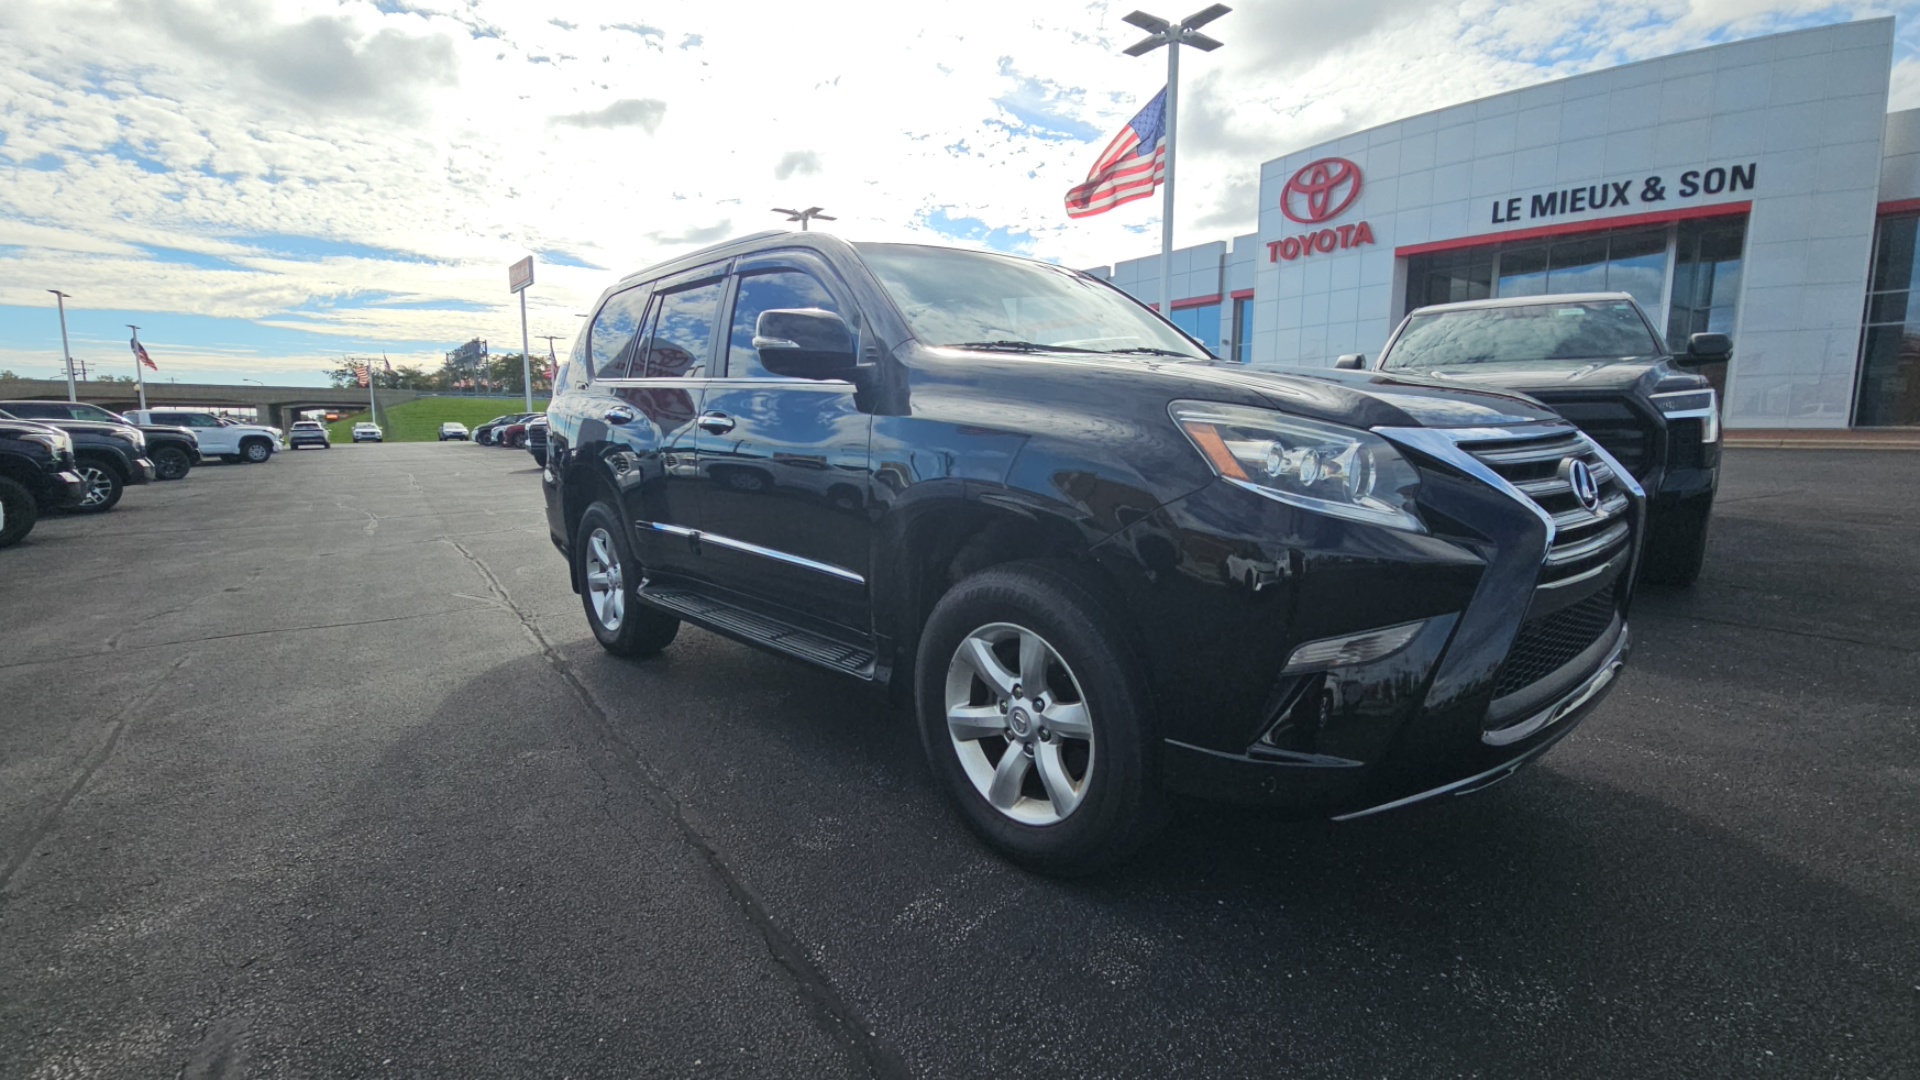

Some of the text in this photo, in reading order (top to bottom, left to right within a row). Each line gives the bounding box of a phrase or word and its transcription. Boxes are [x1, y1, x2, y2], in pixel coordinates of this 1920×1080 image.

[1491, 162, 1756, 224] LE MIEUX & SON
[1266, 221, 1375, 263] TOYOTA
